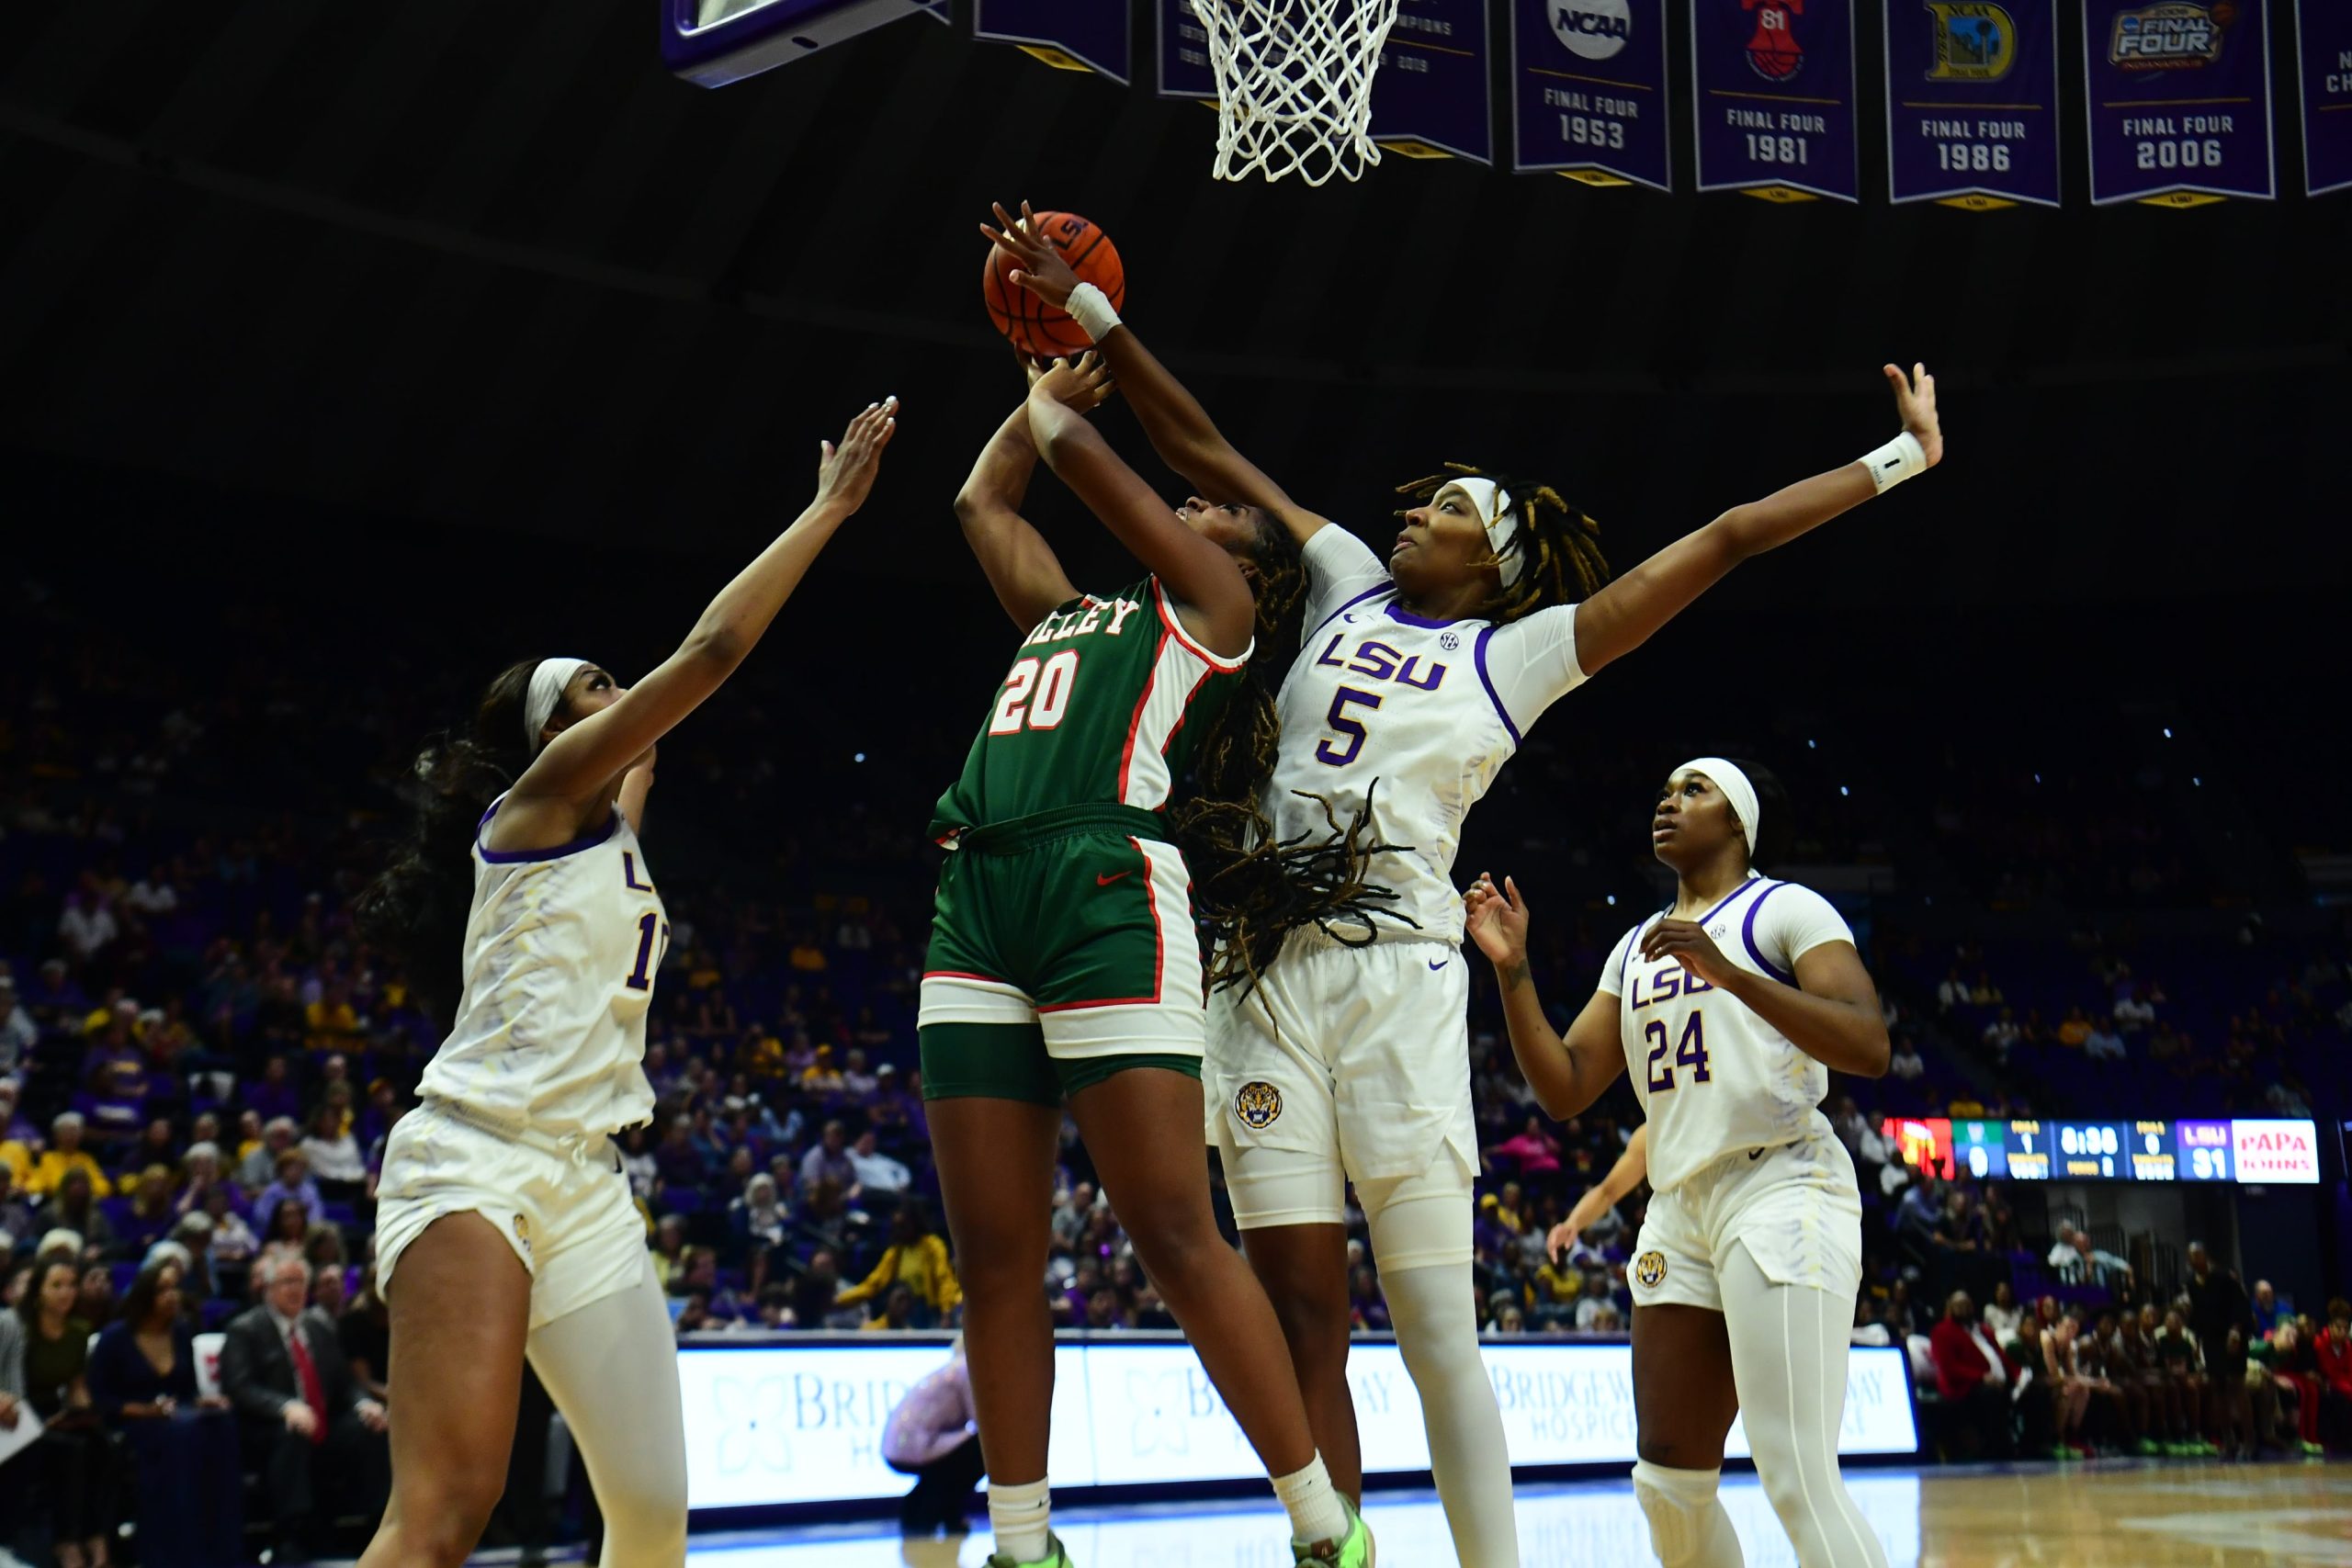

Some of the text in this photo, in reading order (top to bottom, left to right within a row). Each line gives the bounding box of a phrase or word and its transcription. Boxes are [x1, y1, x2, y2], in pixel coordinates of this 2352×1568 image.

[1556, 8, 1630, 43] NCAA
[1760, 8, 1786, 30] 81
[2143, 19, 2209, 33] FINAL
[2119, 33, 2210, 53] FOUR
[1544, 88, 1639, 119] FINAL FOUR
[1559, 114, 1625, 150] 1953
[1726, 108, 1826, 135] FINAL FOUR
[1921, 119, 2027, 140] FINAL FOUR
[2122, 115, 2234, 137] FINAL FOUR
[1747, 134, 1808, 165] 1981
[1938, 143, 2011, 173] 1986
[2137, 139, 2222, 170] 2006
[1020, 597, 1140, 649] LLEY
[1316, 632, 1449, 691] LSU
[989, 648, 1080, 737] 20
[1314, 682, 1385, 768] 5
[1645, 1010, 1712, 1094] 24
[2240, 1133, 2307, 1152] PAPA
